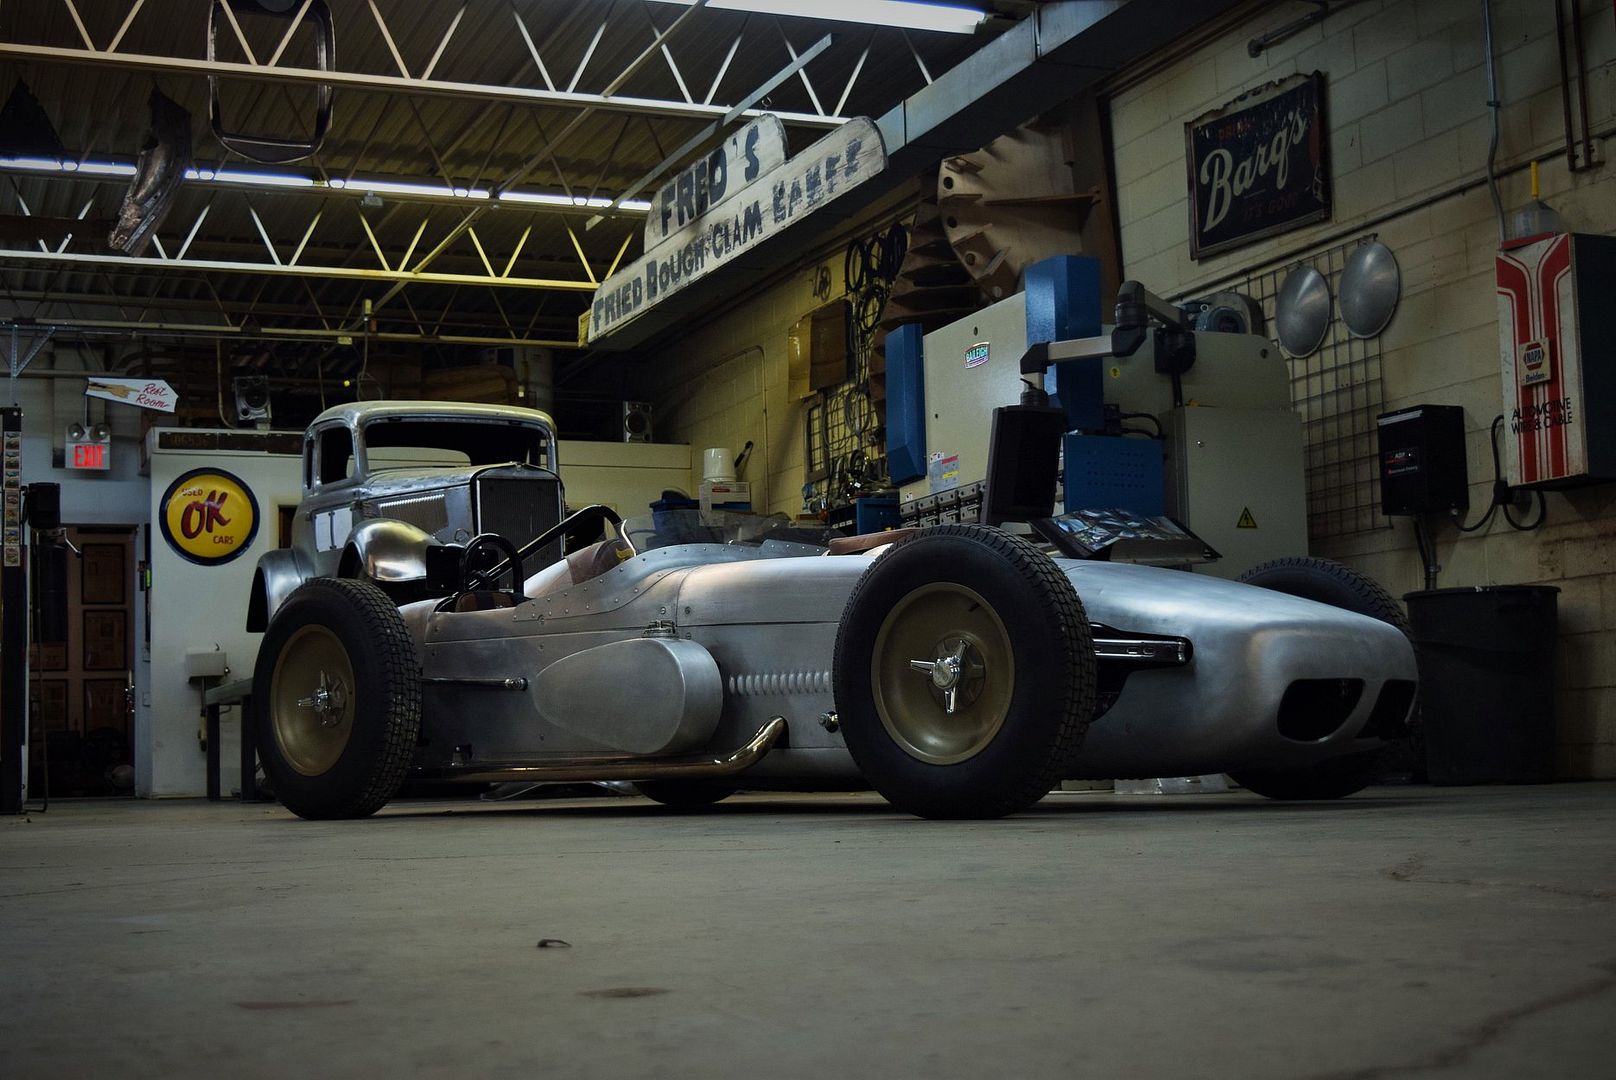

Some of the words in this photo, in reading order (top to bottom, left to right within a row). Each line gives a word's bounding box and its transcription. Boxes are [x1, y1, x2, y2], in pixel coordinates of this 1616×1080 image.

[661, 124, 760, 237] FRED'S
[1200, 107, 1307, 233] Barq's
[593, 277, 642, 332] FRIED
[712, 200, 763, 259] CLAM
[1526, 349, 1543, 364] NAPA
[136, 394, 169, 408] Room
[143, 382, 168, 396] Rest
[1511, 397, 1572, 421] AUTOMOTIVE
[1511, 417, 1536, 435] WIRE
[1535, 418, 1542, 431] &
[1544, 411, 1573, 429] CABLE
[74, 445, 104, 467] EXIT
[181, 489, 232, 540] OK
[213, 535, 235, 545] CARS
